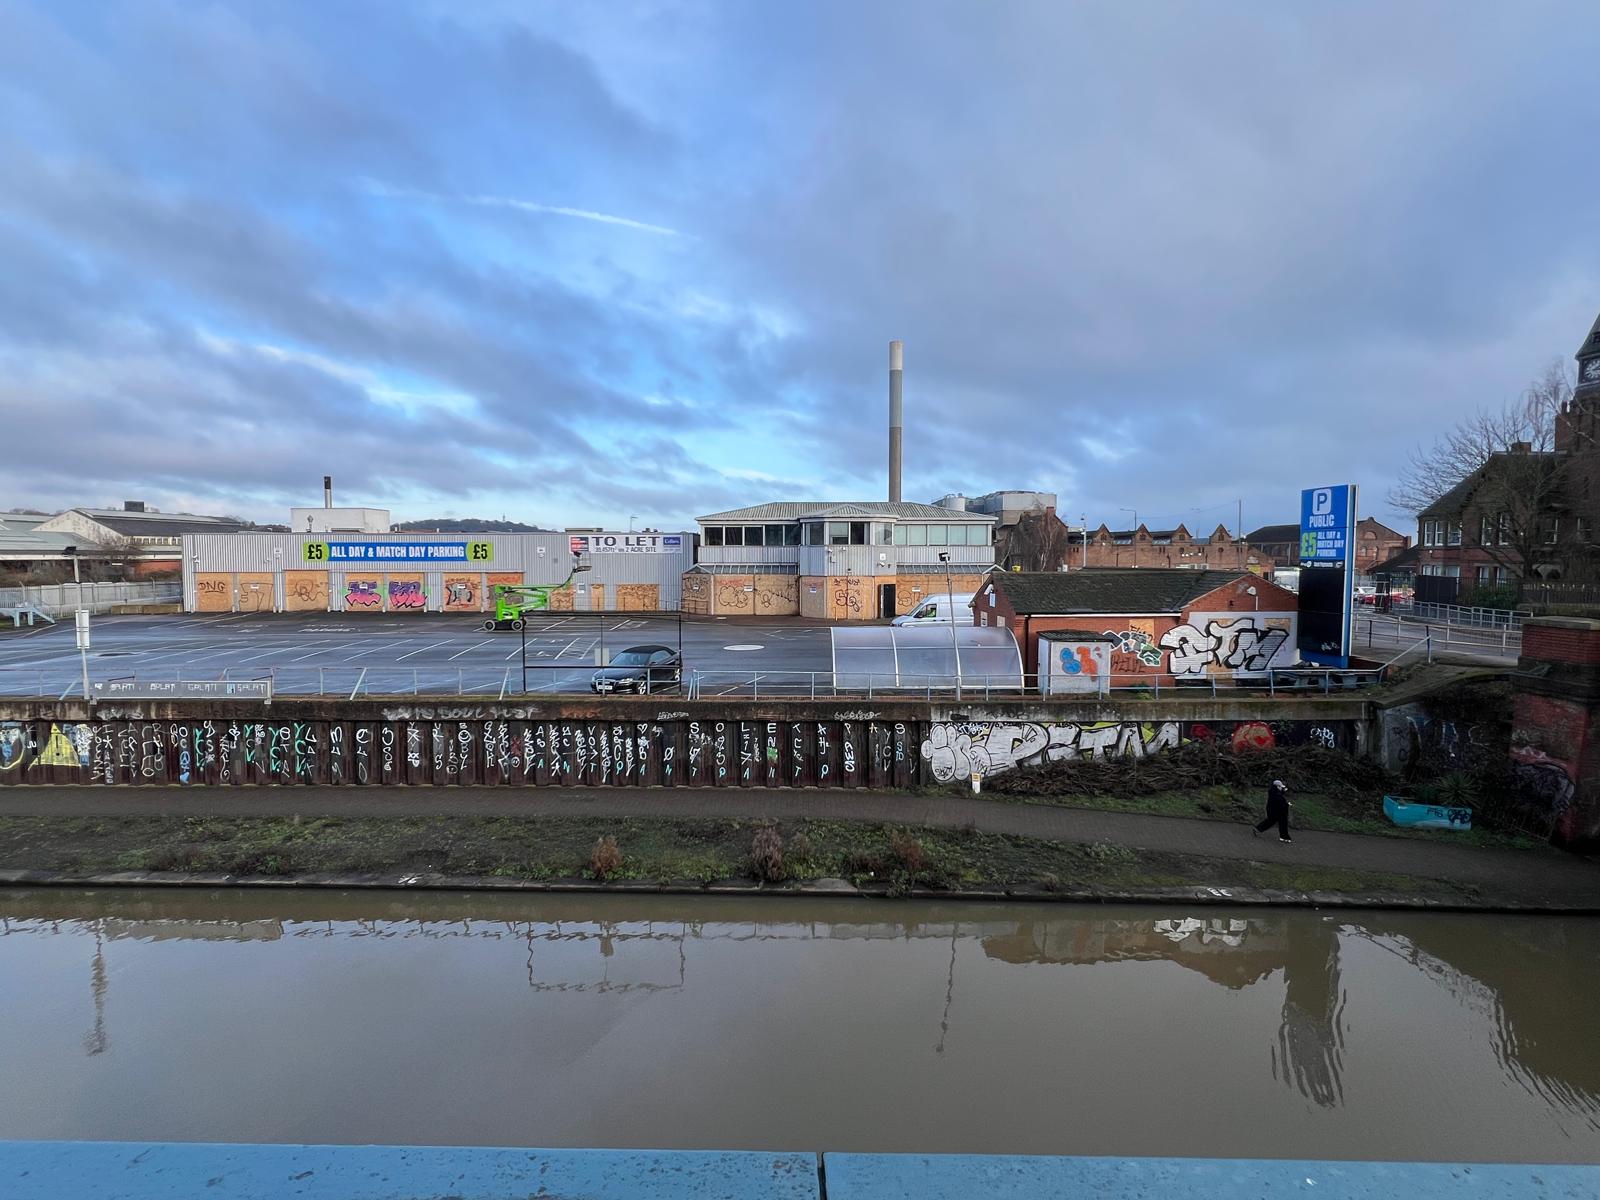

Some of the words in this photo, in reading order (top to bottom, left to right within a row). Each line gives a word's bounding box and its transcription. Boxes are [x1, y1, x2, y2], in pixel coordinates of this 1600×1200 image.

[1309, 514, 1335, 528] PUBLIC
[592, 536, 617, 546] TO
[625, 536, 660, 546] LET
[1317, 532, 1326, 540] ALL
[1326, 531, 1336, 539] DAY
[1301, 531, 1317, 557] £5
[1317, 540, 1333, 549] MATCH
[1334, 540, 1345, 548] DAY
[307, 543, 323, 560] £5
[331, 545, 347, 558] ALL
[349, 545, 366, 558] DAY
[367, 545, 374, 558] &
[376, 545, 407, 558] MATCH
[409, 545, 426, 558] DAY
[427, 545, 465, 558] PARKING
[473, 543, 488, 560] £5
